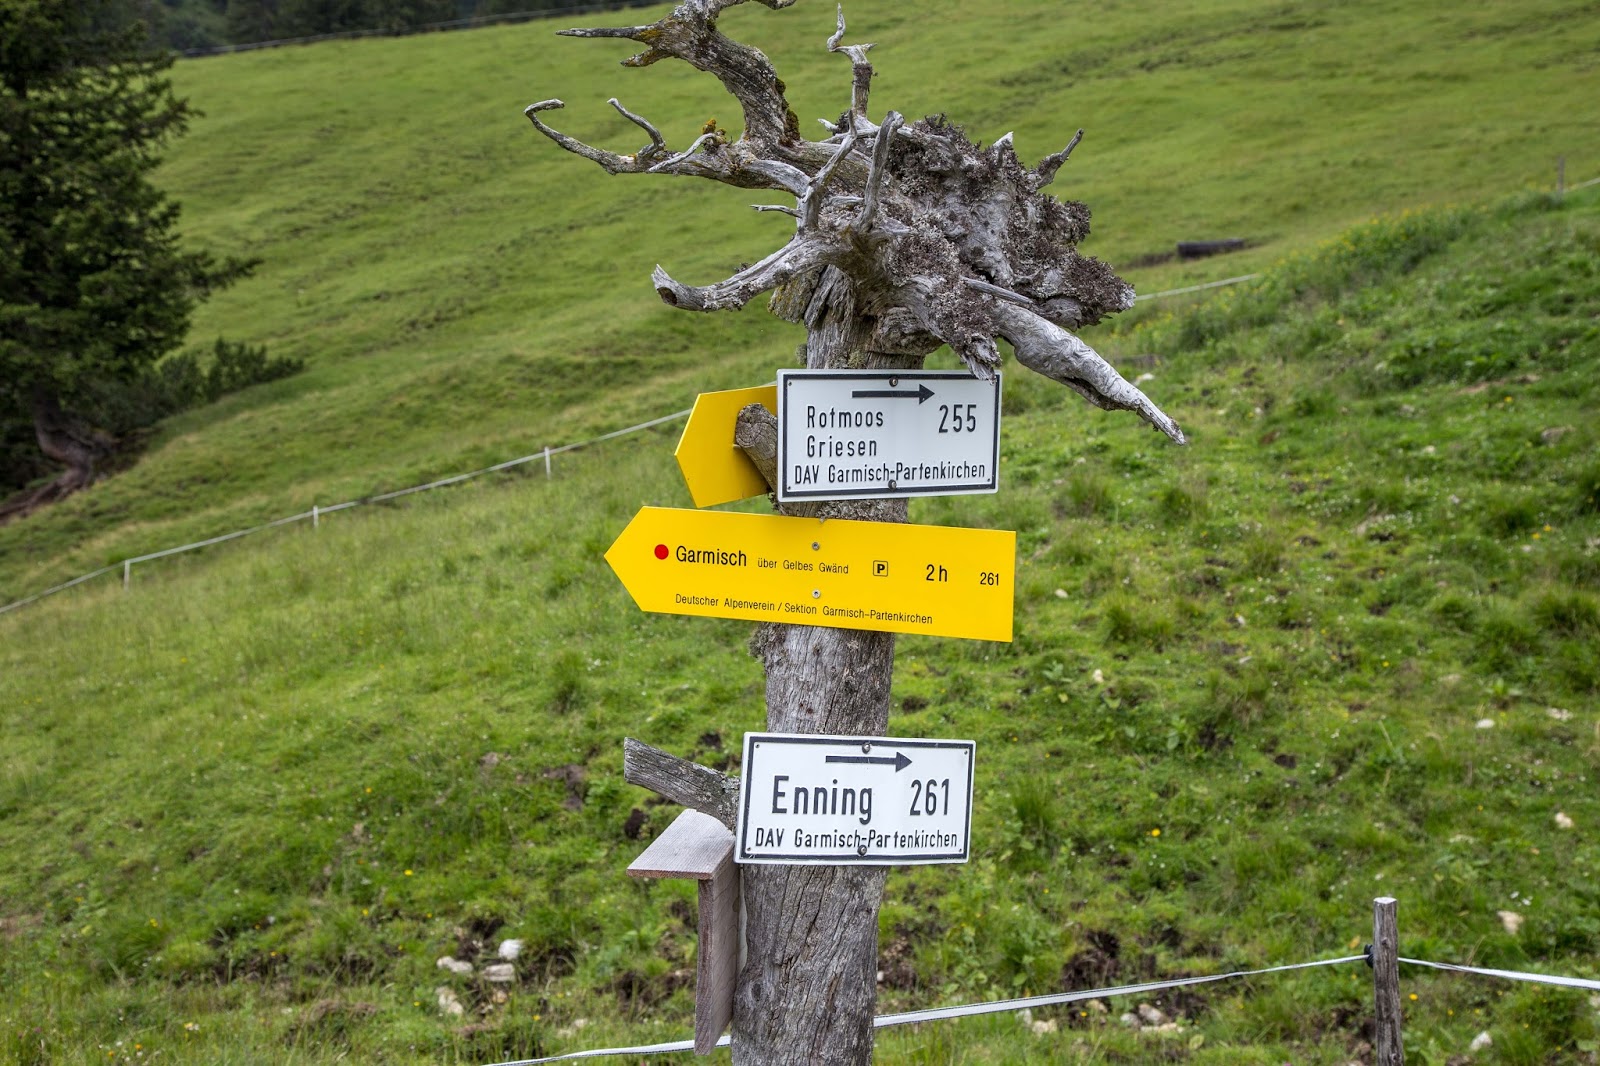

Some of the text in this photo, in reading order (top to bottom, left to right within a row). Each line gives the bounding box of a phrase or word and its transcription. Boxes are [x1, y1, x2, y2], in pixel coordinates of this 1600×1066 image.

[807, 404, 977, 433] Rotmoos 255
[807, 435, 877, 458] Griesen
[794, 461, 985, 485] DAV Garmisch-Partenkirchen
[675, 545, 747, 567] Garmisch
[757, 558, 777, 569] über
[783, 559, 813, 571] Gelbes
[818, 562, 849, 574] Gwänd
[979, 572, 999, 586] 261
[675, 593, 719, 606] Deutscher
[724, 598, 775, 611] Alpenverein
[784, 603, 817, 615] Sektion
[822, 605, 933, 625] Garmisch-Partenkirchen
[771, 775, 950, 825] Enning 261
[755, 827, 957, 848] DAV Garmisch-Partenkirchen
